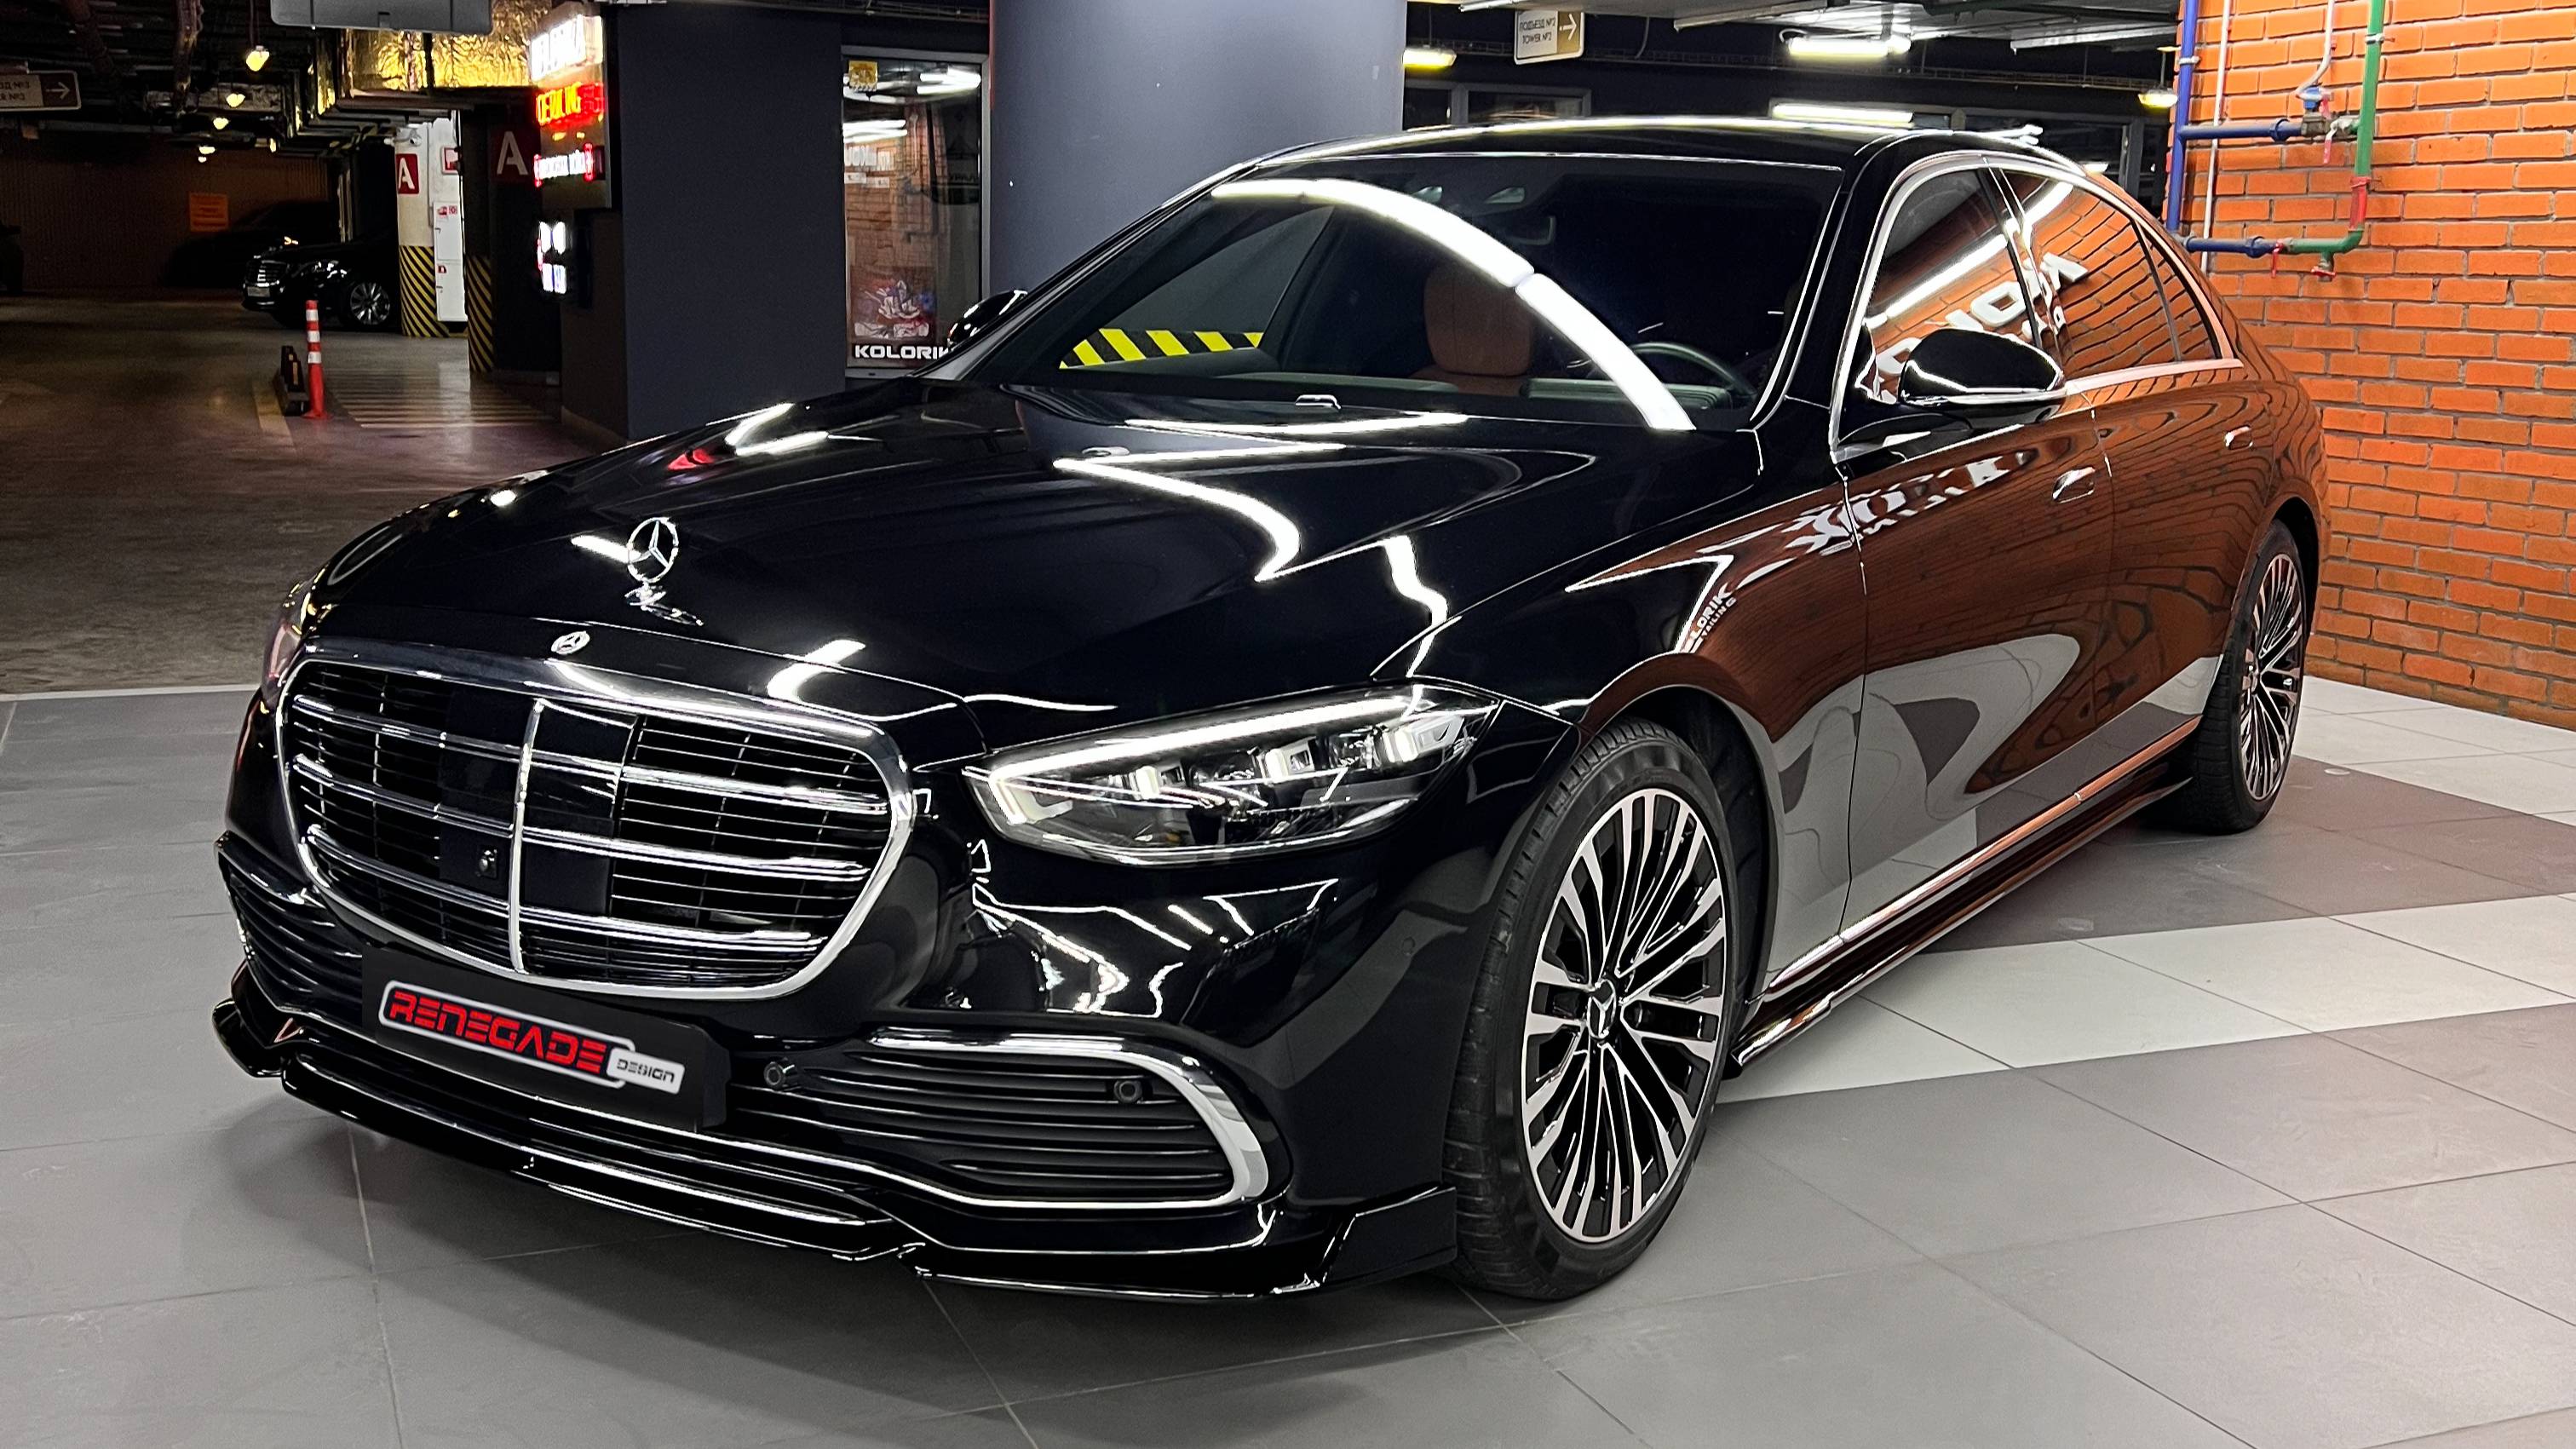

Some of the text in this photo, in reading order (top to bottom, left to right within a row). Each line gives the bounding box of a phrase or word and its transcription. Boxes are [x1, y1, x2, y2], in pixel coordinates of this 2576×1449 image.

[497, 131, 529, 175] A
[398, 158, 416, 190] A
[388, 990, 607, 1074] RENEGADE
[616, 1058, 676, 1084] DESIGN
